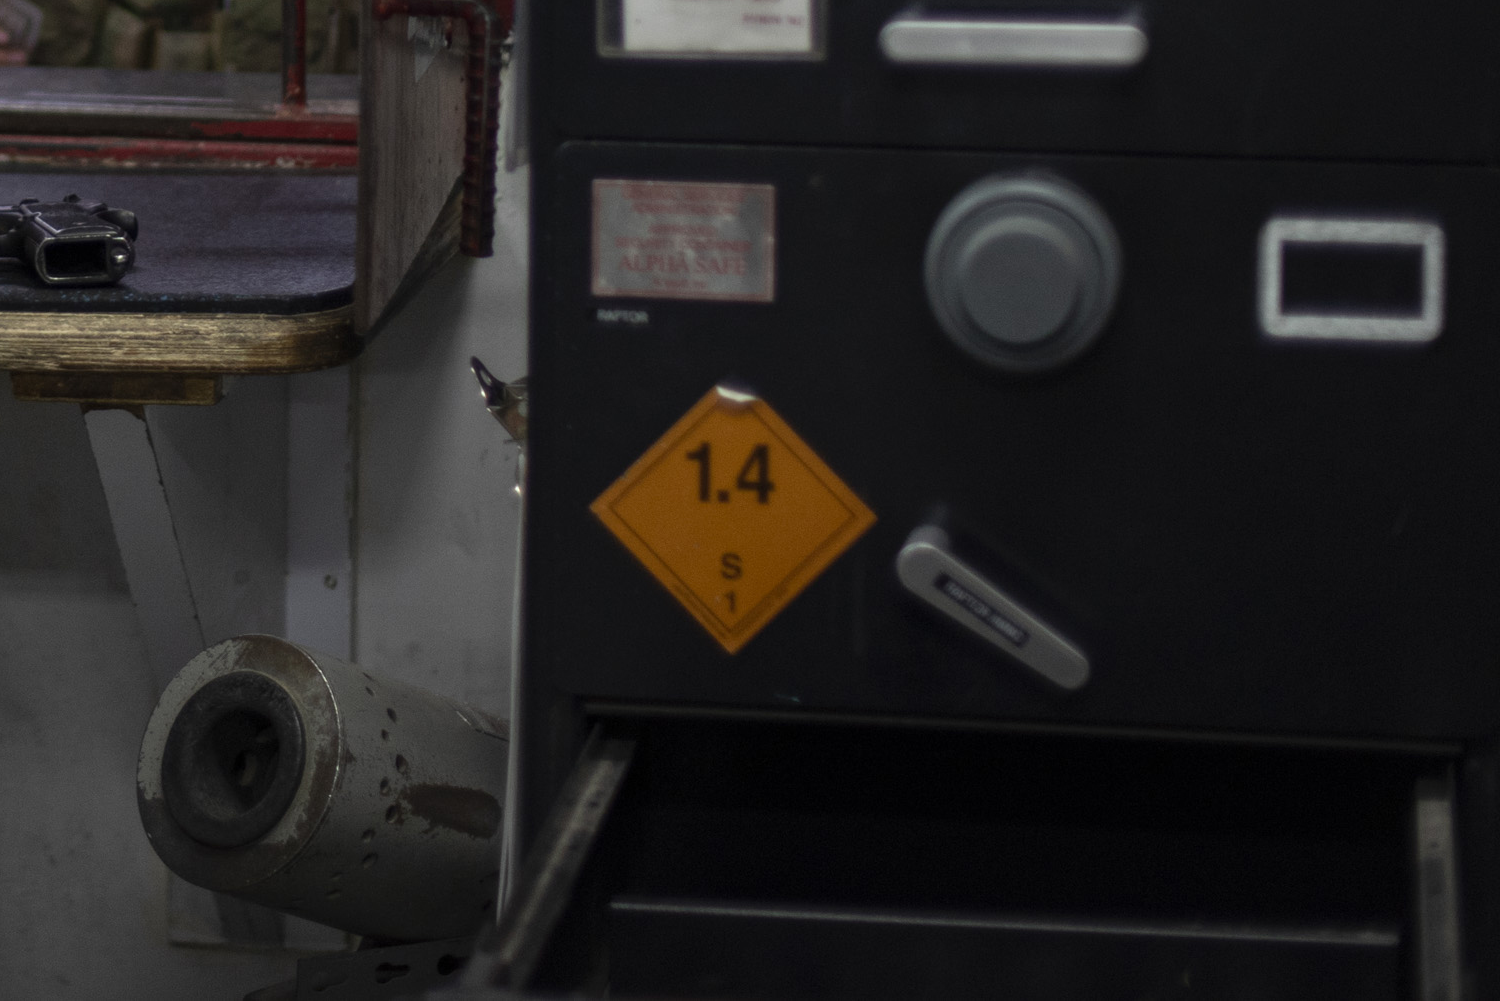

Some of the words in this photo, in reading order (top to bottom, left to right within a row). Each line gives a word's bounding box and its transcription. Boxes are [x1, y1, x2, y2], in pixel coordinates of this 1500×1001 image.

[685, 442, 776, 505] 1.4
[719, 552, 743, 581] S
[723, 591, 737, 615] 1
